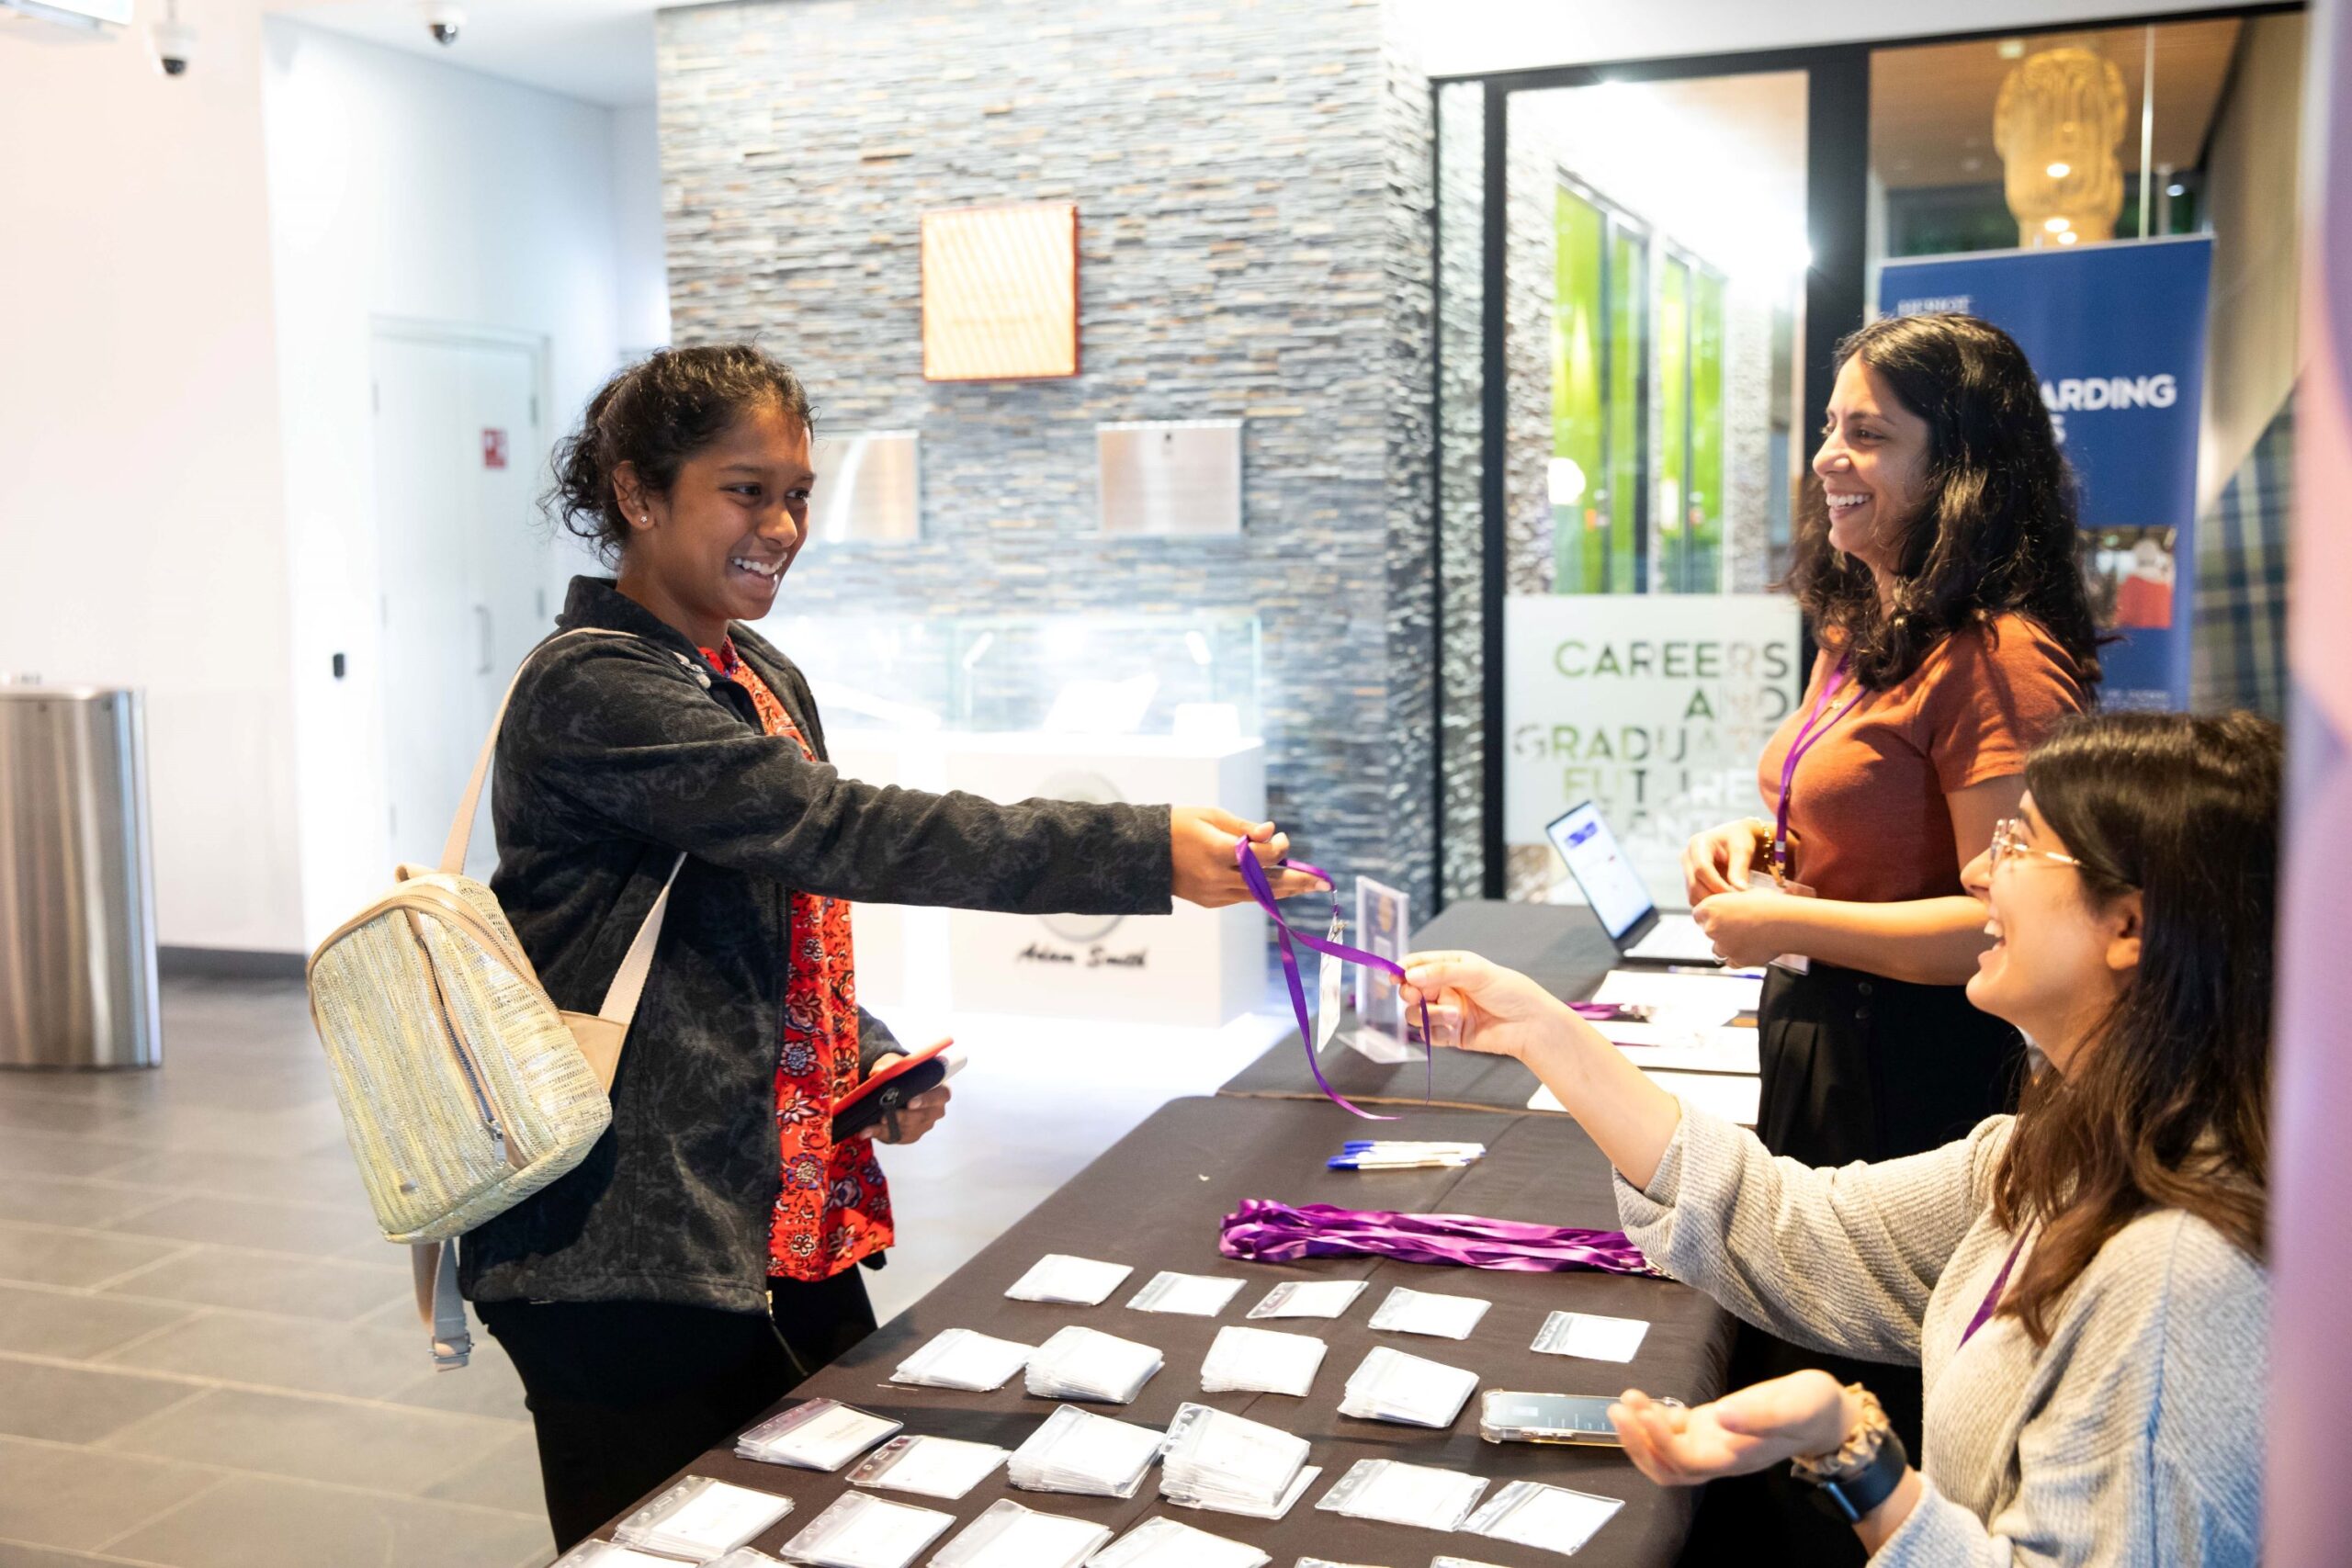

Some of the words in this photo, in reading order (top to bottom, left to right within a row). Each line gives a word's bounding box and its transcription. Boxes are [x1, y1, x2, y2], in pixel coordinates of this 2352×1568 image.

[2040, 373, 2177, 412] ARDING
[1554, 640, 1789, 679] CAREERS
[1512, 724, 1777, 763] GRADUAT
